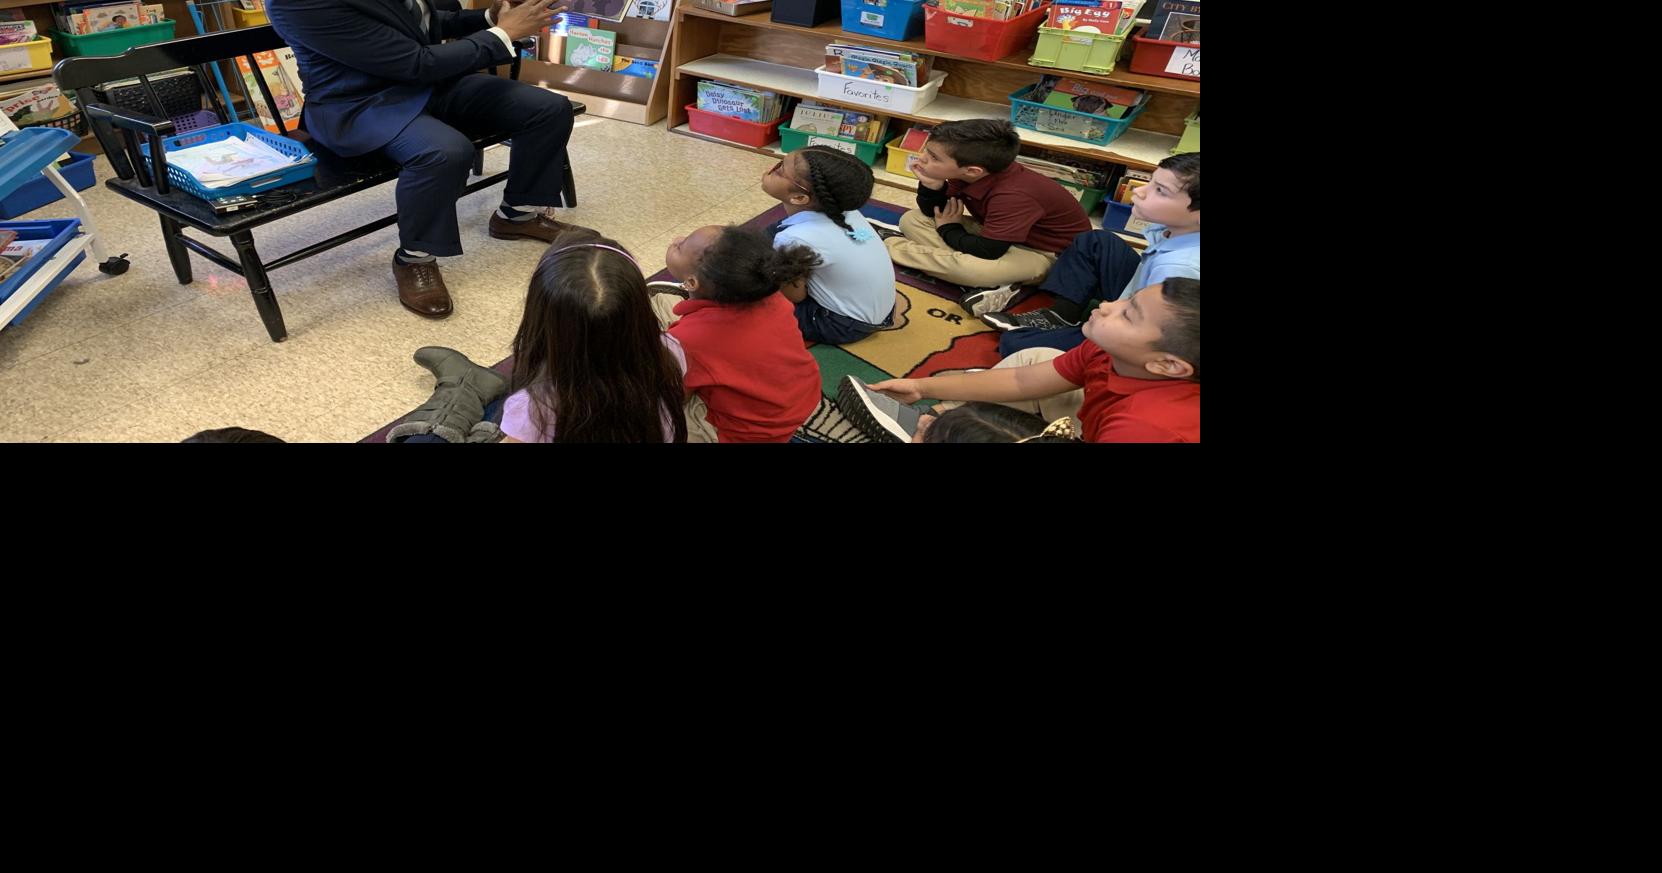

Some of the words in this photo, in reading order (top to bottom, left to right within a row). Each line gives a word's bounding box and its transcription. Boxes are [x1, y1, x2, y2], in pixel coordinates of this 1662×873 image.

[1060, 7, 1082, 16] Big
[1084, 8, 1111, 18] Egg
[705, 90, 725, 98] Daisy
[843, 81, 890, 103] Favorites
[712, 97, 745, 107] Dinosaur
[809, 135, 853, 154] Fites
[927, 308, 963, 325] OR
